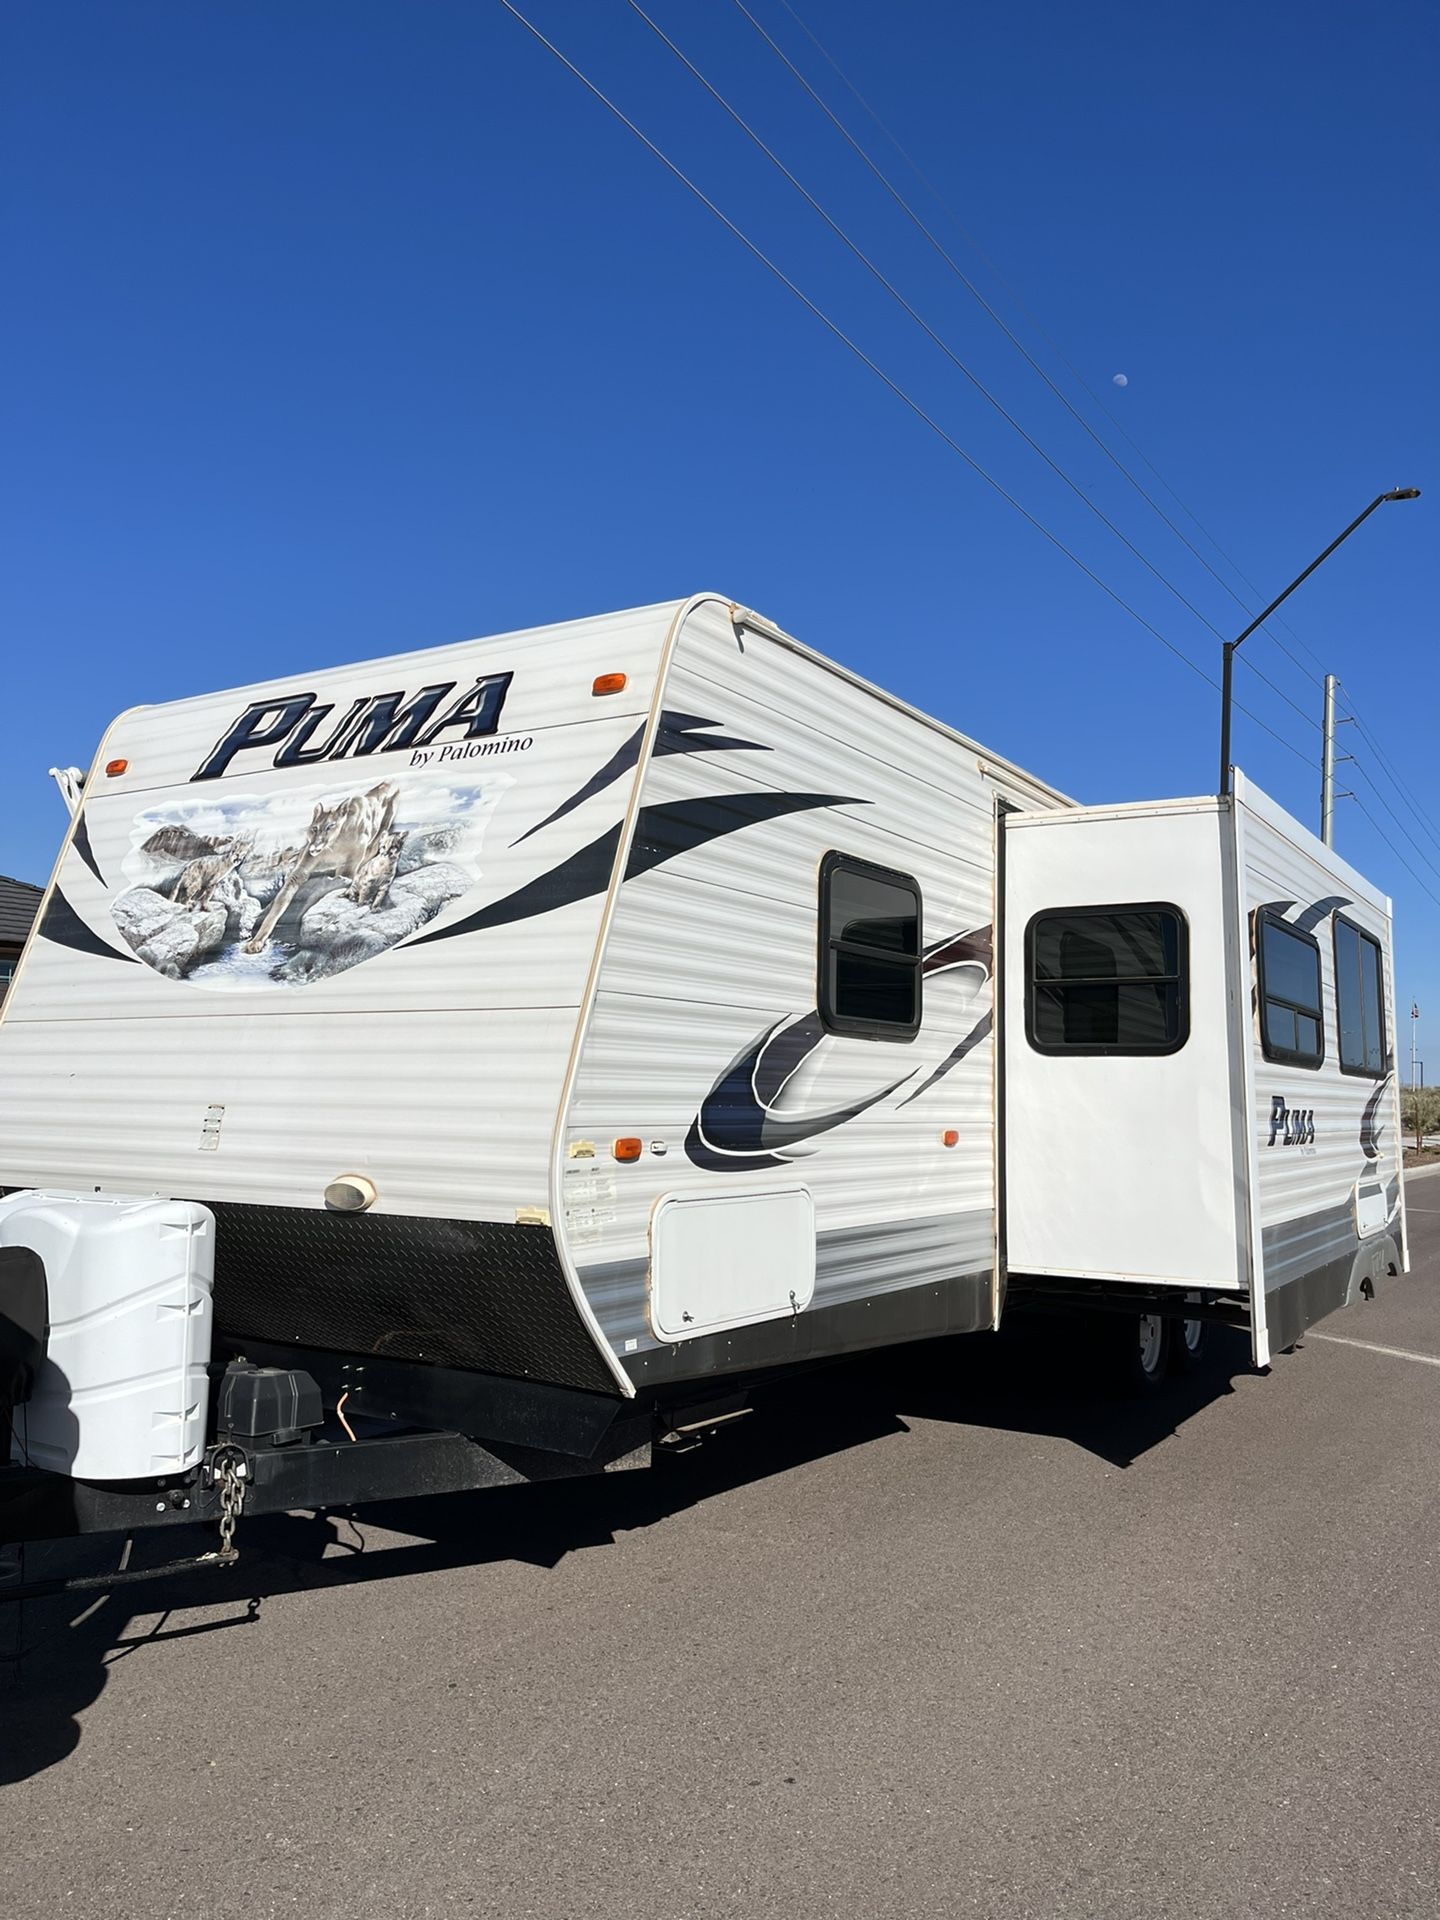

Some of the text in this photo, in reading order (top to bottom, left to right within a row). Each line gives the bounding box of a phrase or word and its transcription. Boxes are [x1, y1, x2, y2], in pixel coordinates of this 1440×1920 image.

[189, 670, 515, 782] PUMA
[409, 736, 534, 768] by Palomino
[1267, 1095, 1315, 1147] PUMA
